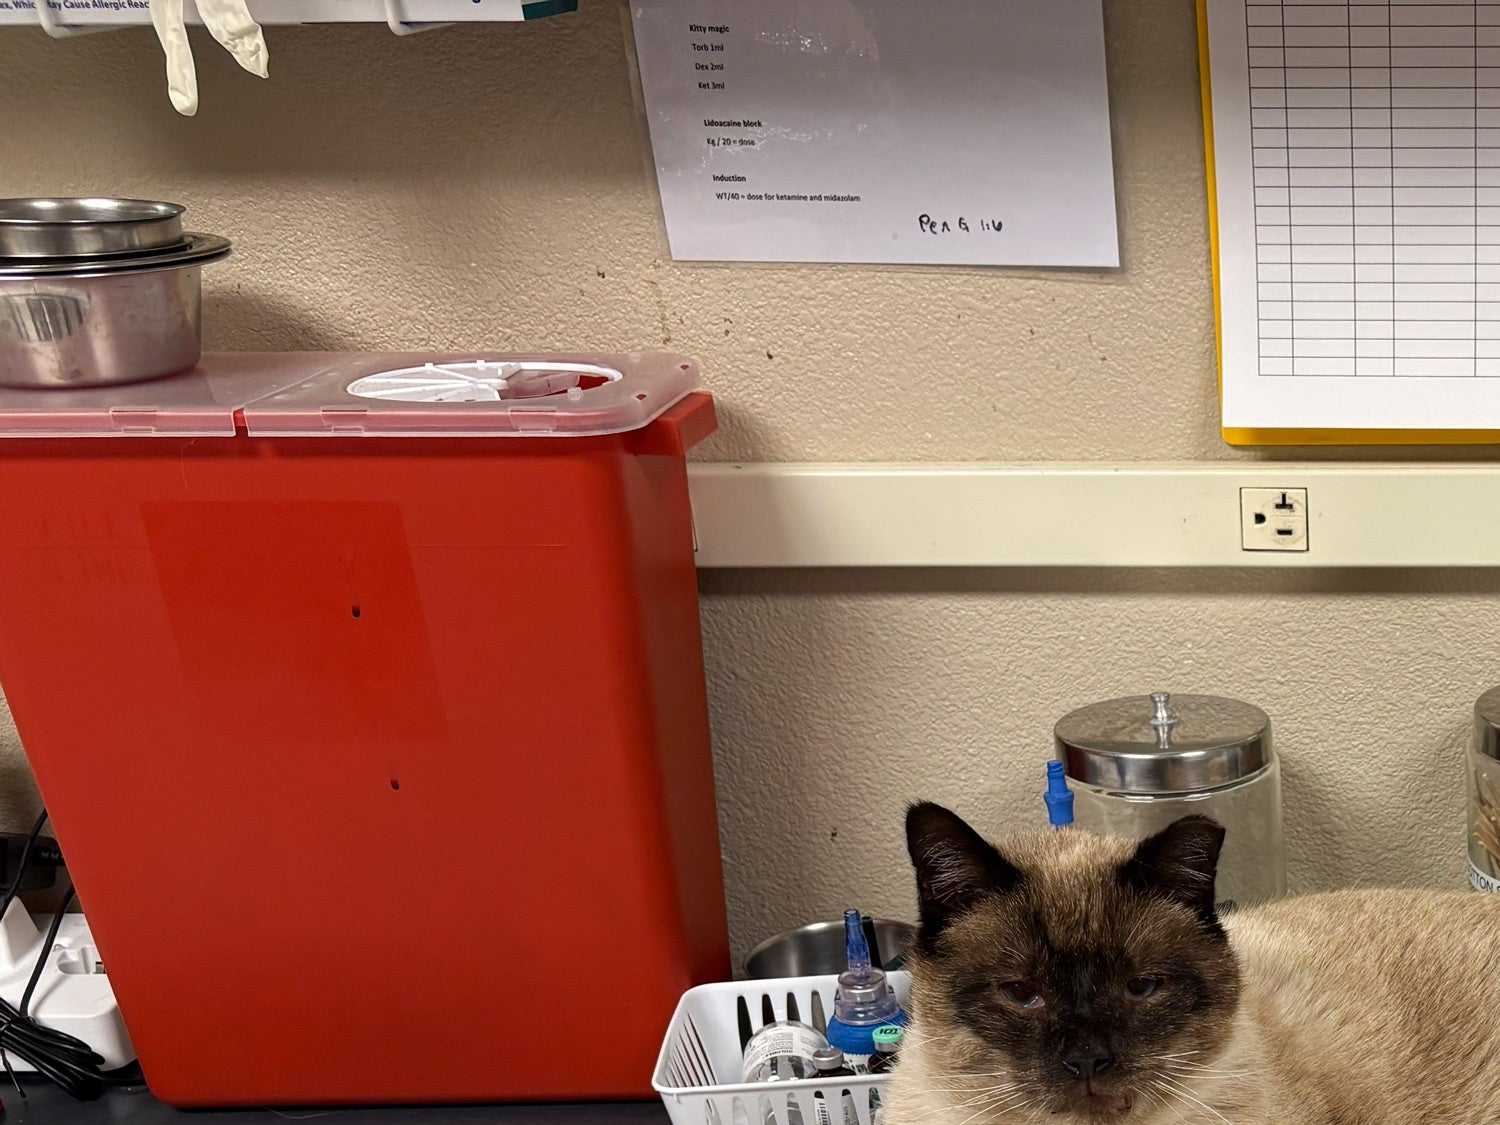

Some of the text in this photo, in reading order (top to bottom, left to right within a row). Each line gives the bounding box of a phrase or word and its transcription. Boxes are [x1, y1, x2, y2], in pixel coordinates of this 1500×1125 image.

[12, 0, 37, 9] Whic
[64, 0, 91, 9] Cause
[92, 0, 127, 11] Allergic
[128, 0, 149, 9] Reac
[689, 24, 729, 34] Kitty magic
[692, 43, 708, 51] Torb
[710, 63, 723, 71] 2ml
[704, 119, 741, 127] Lidoacaine
[707, 138, 716, 147] Kg
[738, 138, 755, 146] dose
[713, 174, 746, 182] Induction
[716, 193, 739, 201] WT/40
[919, 214, 950, 234] Pen
[959, 217, 969, 232] G
